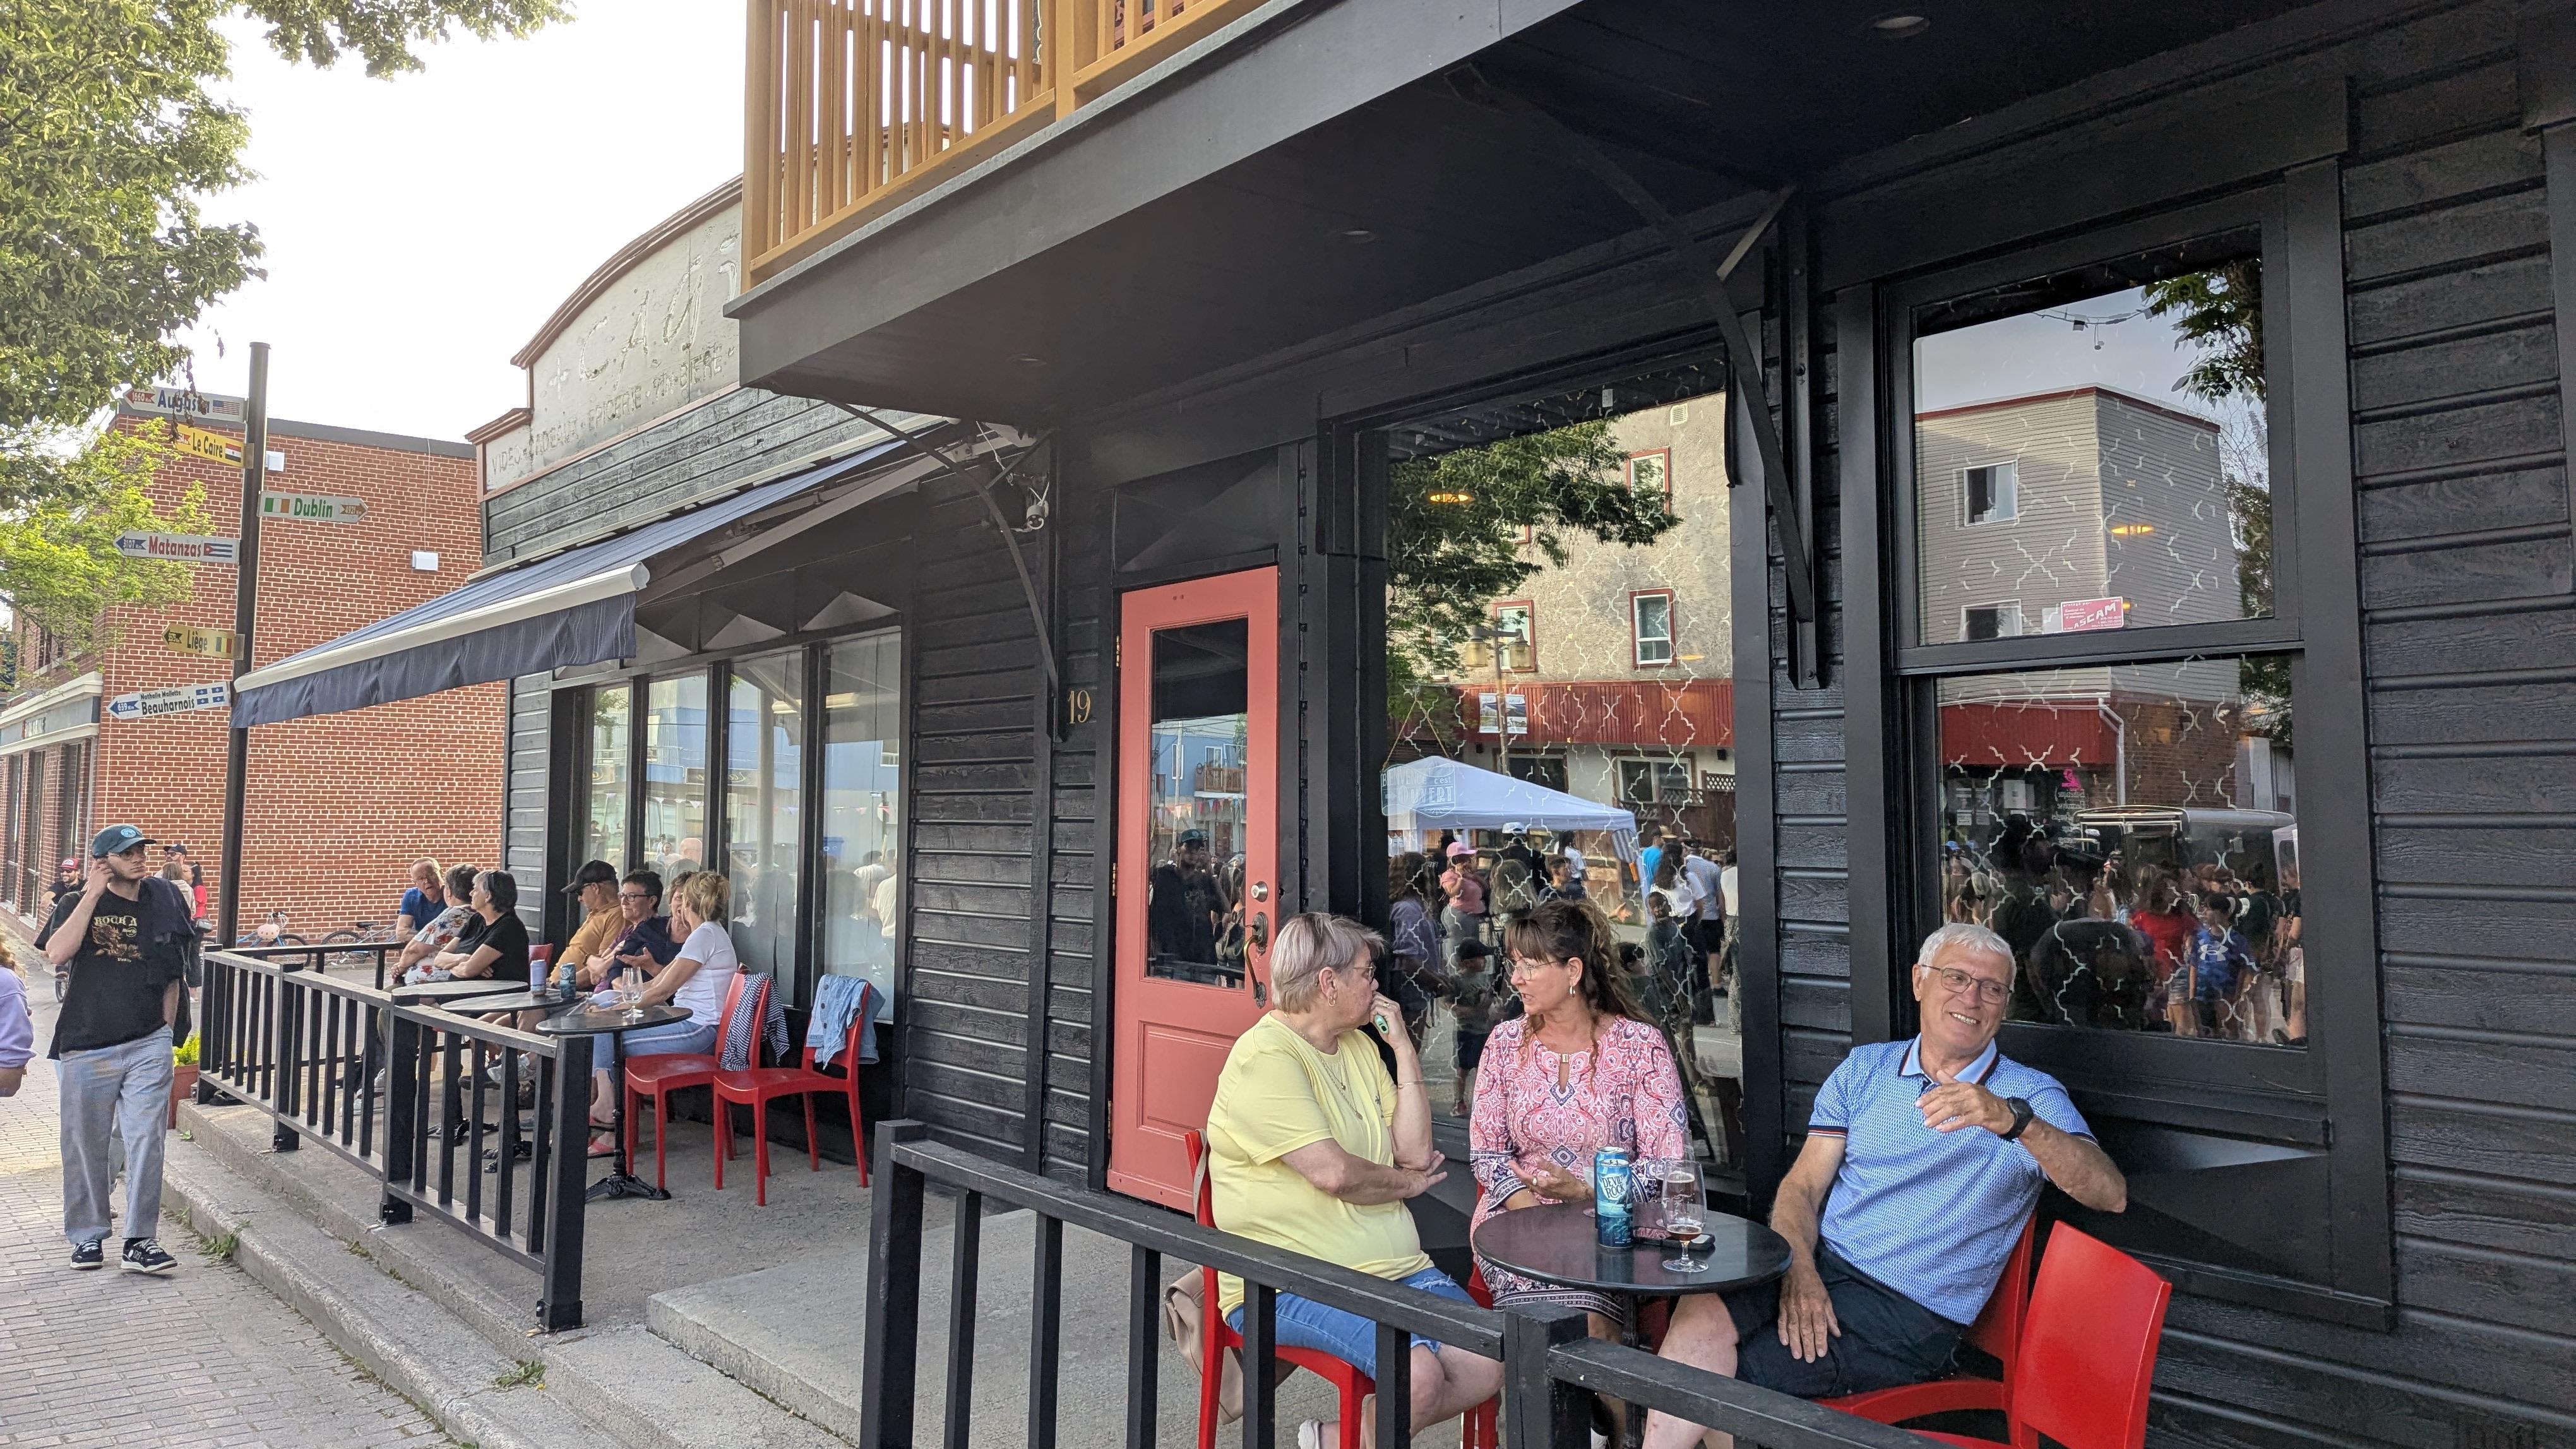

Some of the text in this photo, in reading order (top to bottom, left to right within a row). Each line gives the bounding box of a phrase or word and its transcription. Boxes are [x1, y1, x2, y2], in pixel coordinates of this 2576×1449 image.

[193, 432, 201, 452] Le
[203, 436, 223, 458] Caire
[294, 498, 333, 518] Dublin
[148, 535, 201, 558] Matanzas
[2073, 602, 2116, 629] ASCAM
[187, 629, 208, 653] Liège
[141, 696, 195, 715] Beauharnois
[1068, 690, 1091, 724] 19
[1398, 785, 1453, 804] OUVERT
[1605, 1183, 1625, 1198] ROCK
